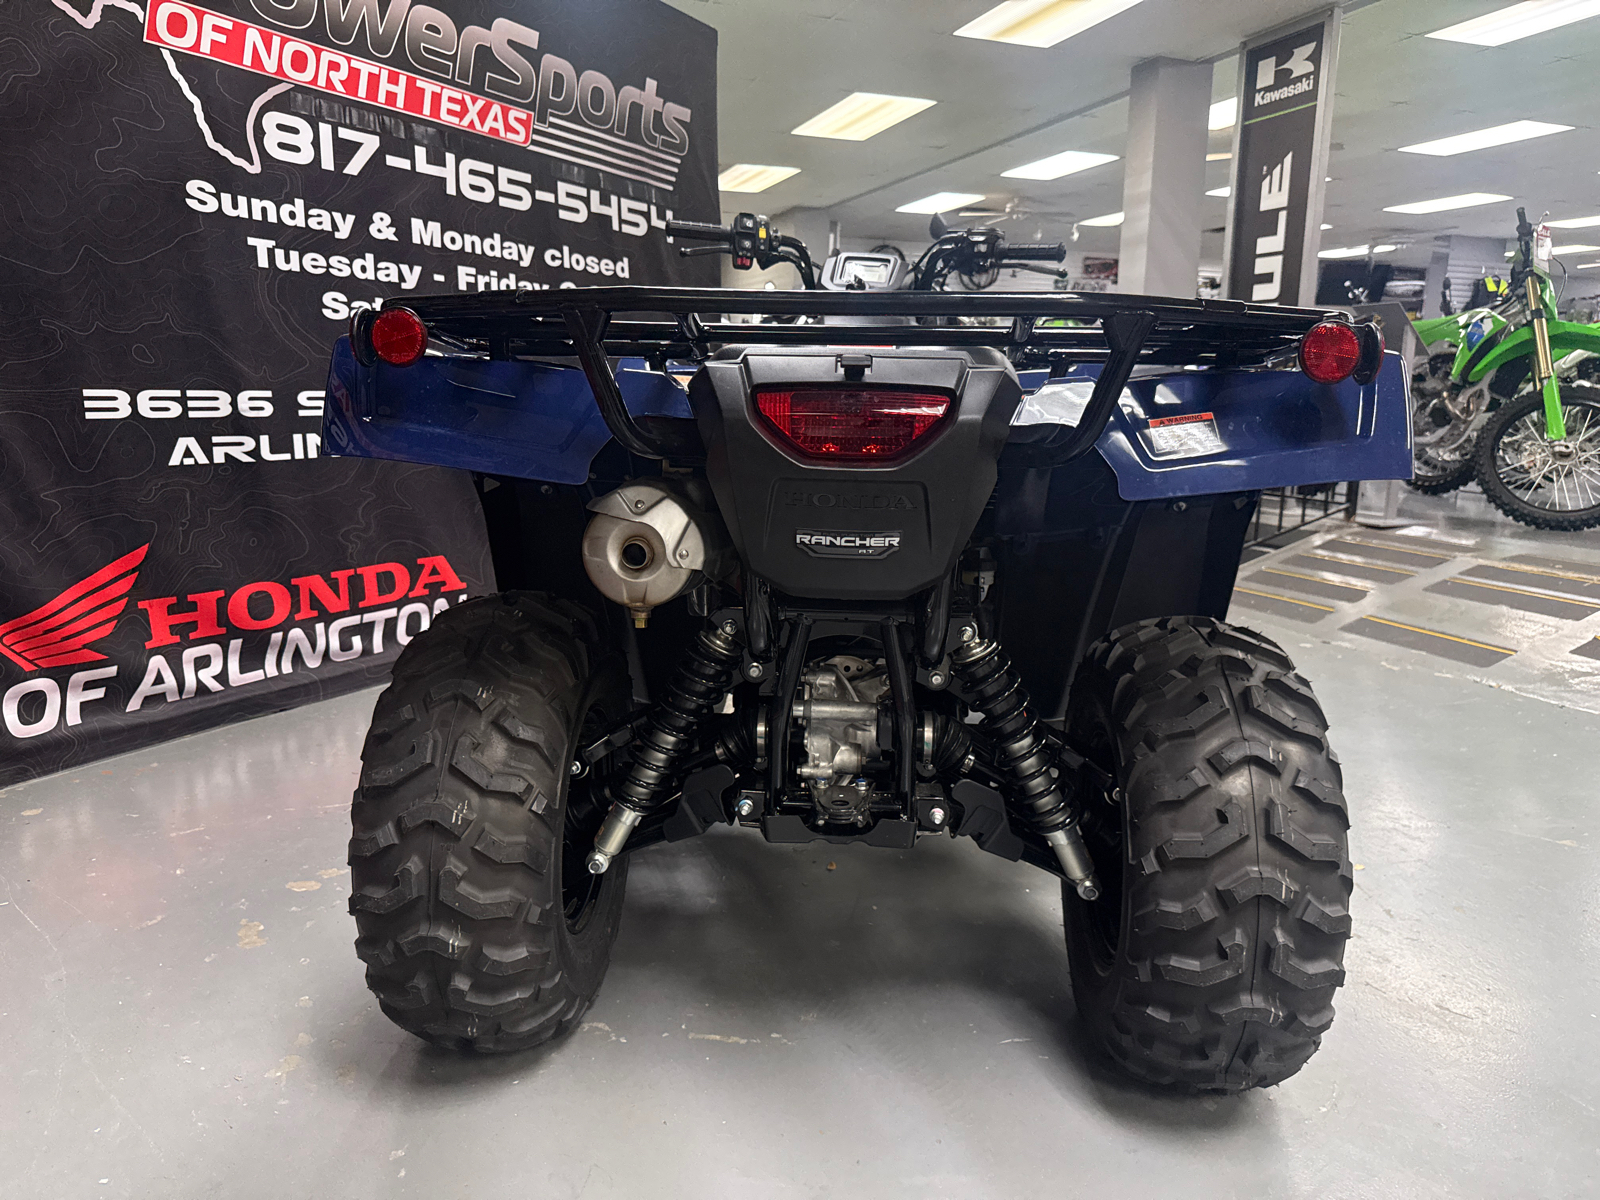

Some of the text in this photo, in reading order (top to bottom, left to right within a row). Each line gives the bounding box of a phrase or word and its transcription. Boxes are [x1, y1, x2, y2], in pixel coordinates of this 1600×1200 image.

[156, 2, 527, 143] OF NORTH TEXAS
[1254, 75, 1314, 107] Kawasaki
[262, 111, 674, 244] 817-465-5454
[185, 179, 630, 279] Sunday & Monday closed
[1252, 151, 1293, 306] ULE
[247, 236, 422, 289] Tuesday
[82, 389, 274, 420] 3636
[1166, 414, 1203, 424] WARNING
[784, 492, 918, 509] HONDA
[796, 534, 900, 547] RANCHER
[139, 555, 467, 649] HONDA
[3, 665, 118, 738] OF
